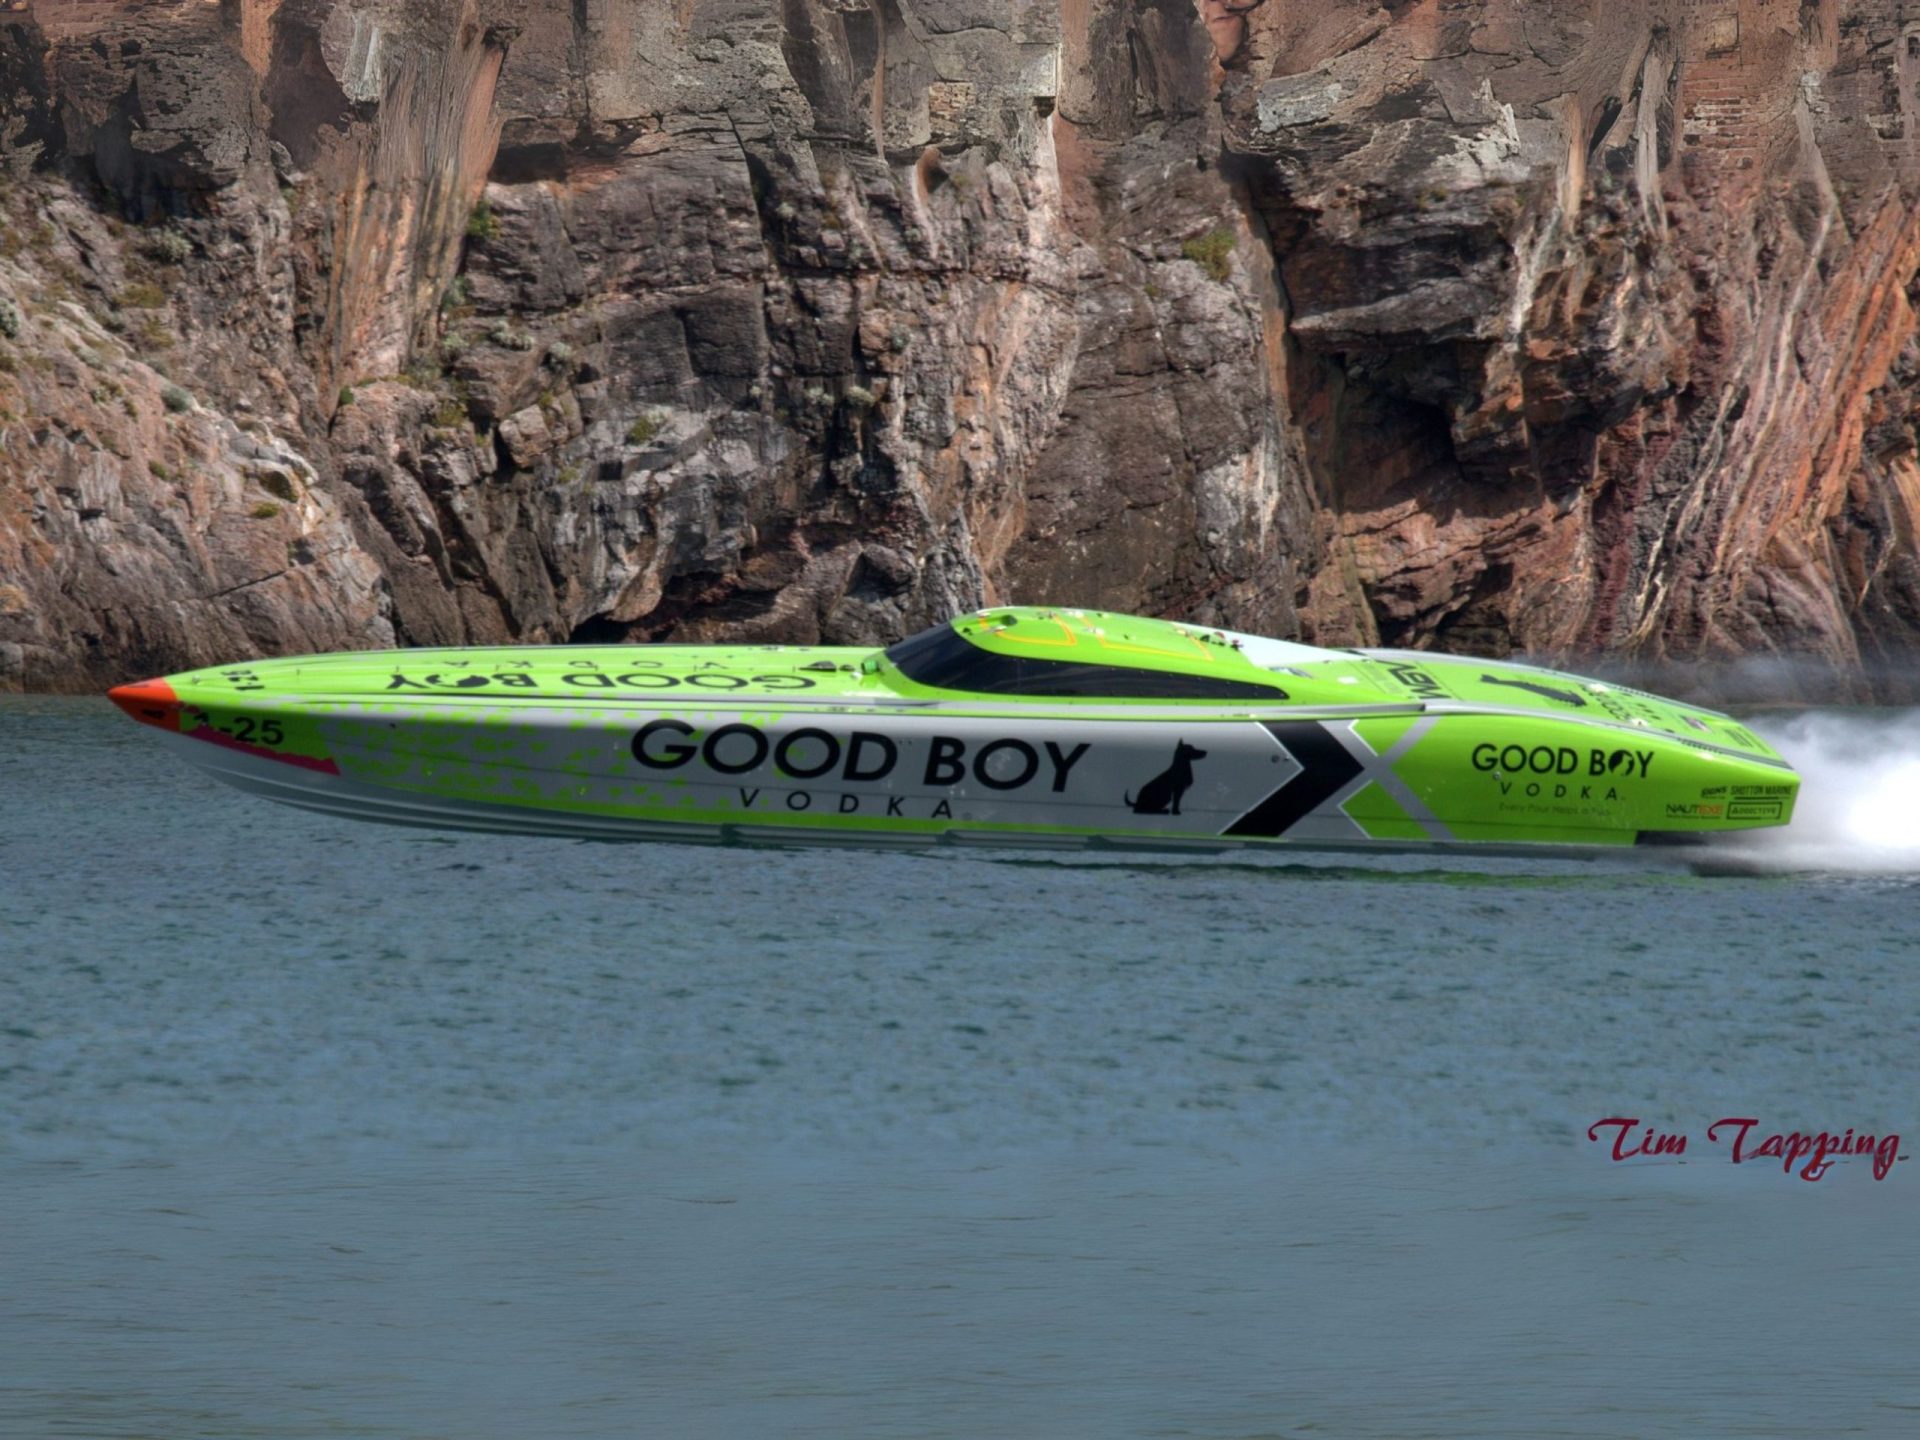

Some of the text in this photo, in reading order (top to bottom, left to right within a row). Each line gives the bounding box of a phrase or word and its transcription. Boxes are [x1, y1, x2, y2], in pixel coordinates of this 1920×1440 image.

[385, 672, 817, 690] GOOD BOY
[630, 718, 1092, 793] GOOD BOY
[1471, 743, 1655, 778] GOOD BOY
[739, 787, 953, 820] VODKA
[1500, 781, 1618, 801] VODKA
